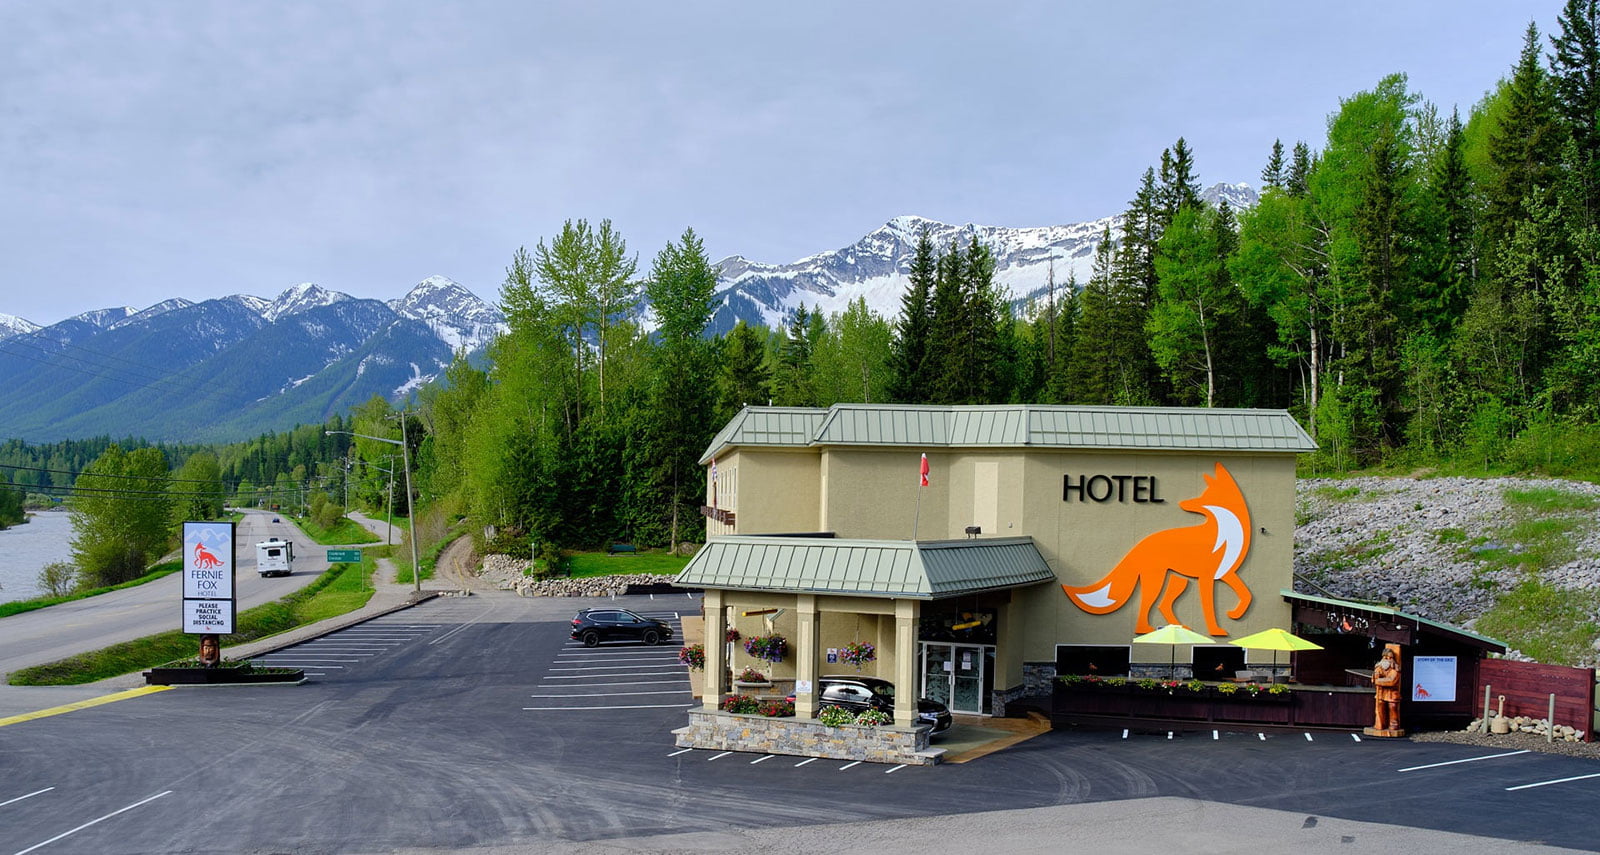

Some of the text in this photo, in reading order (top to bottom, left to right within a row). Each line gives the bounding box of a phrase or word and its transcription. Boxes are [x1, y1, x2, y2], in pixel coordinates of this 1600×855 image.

[1063, 474, 1165, 502] HOTEL
[191, 570, 224, 580] FERNIE
[197, 580, 217, 590] FOX
